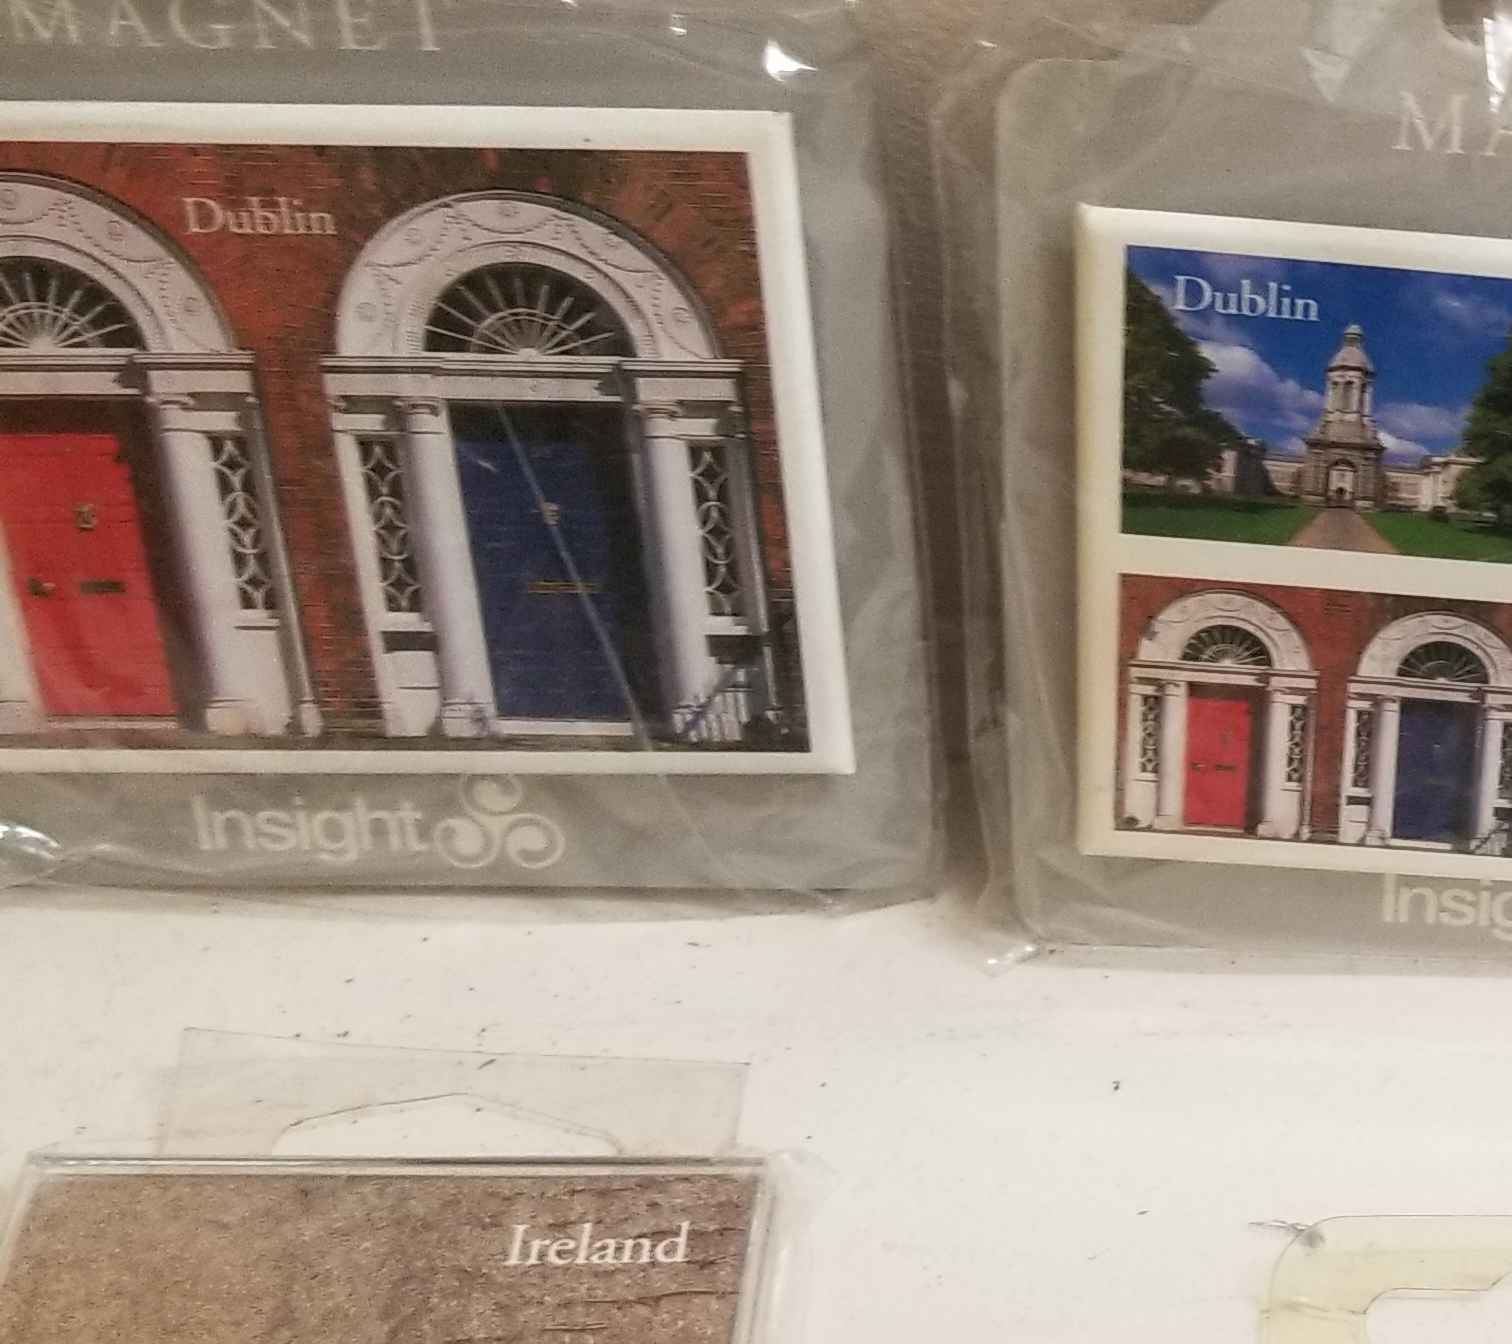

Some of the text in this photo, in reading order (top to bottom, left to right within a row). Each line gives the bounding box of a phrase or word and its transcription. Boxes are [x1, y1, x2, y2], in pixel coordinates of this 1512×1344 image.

[182, 196, 338, 235] Dublin
[1172, 275, 1320, 321] Dublin
[191, 794, 427, 862] Insight
[502, 1220, 692, 1266] Ireland
